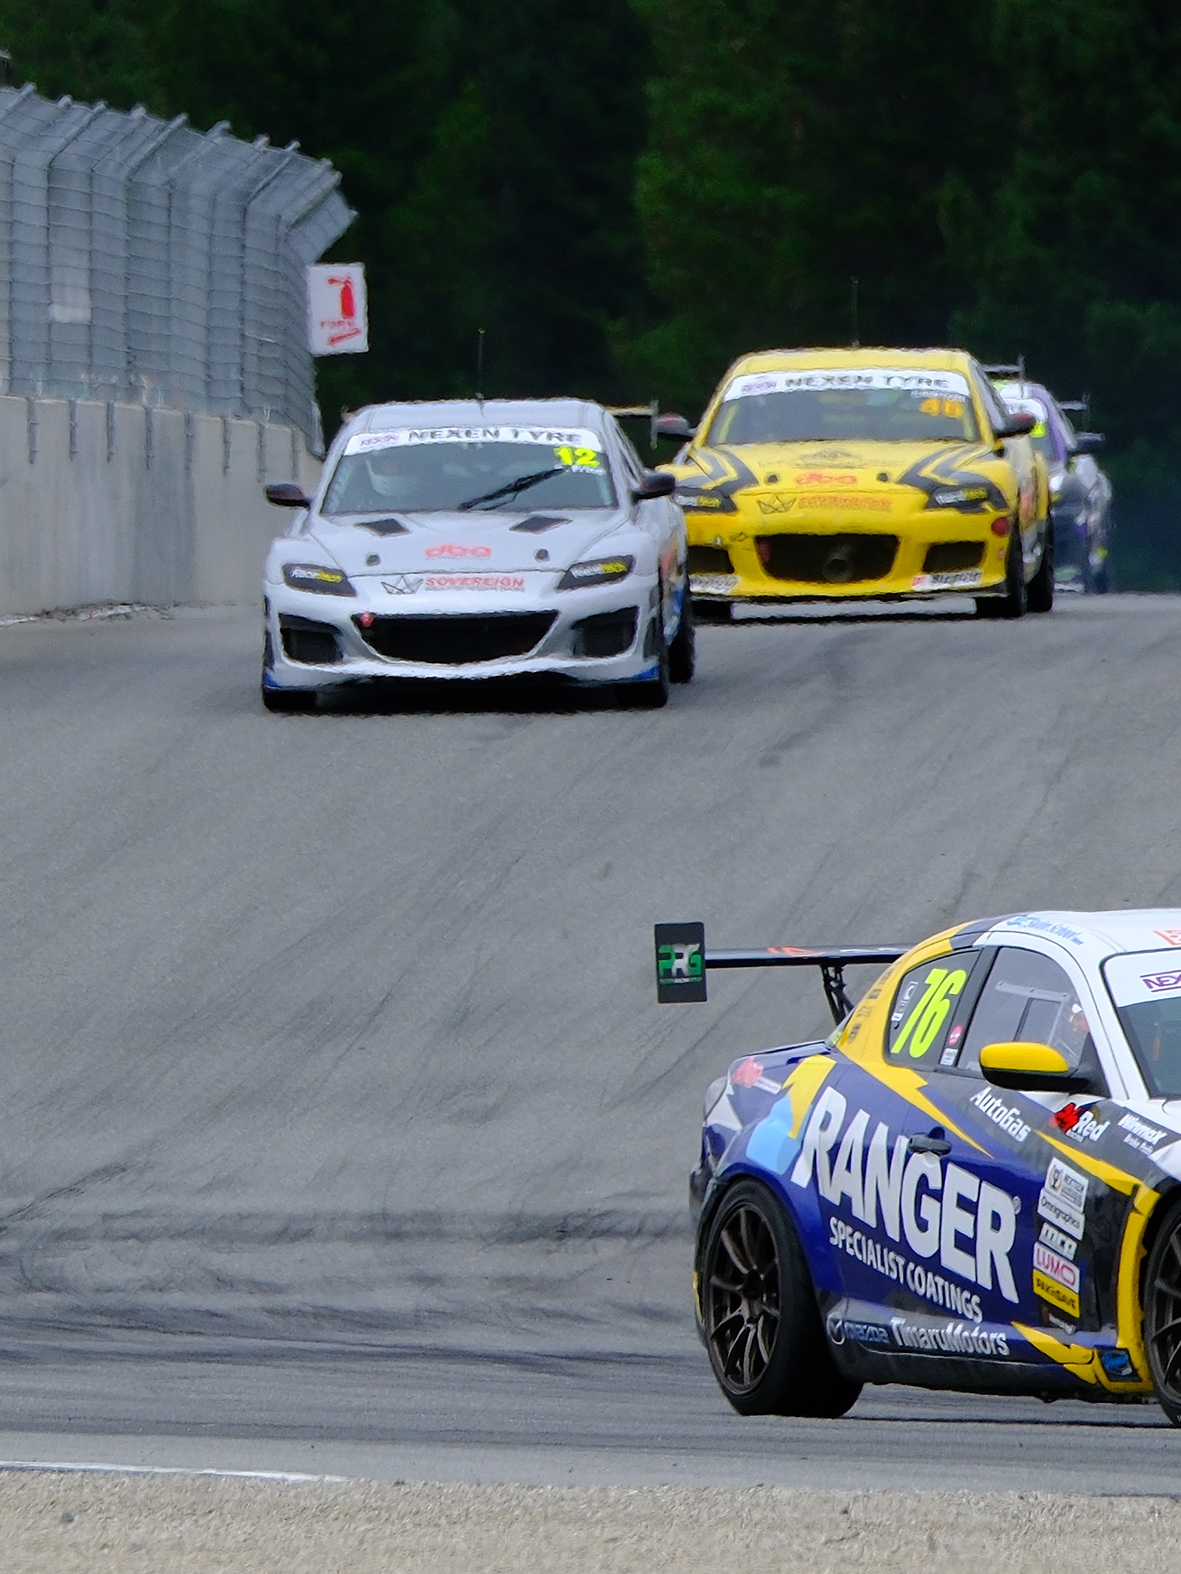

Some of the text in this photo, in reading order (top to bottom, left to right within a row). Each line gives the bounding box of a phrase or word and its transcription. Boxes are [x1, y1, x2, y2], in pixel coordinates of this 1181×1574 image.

[785, 375, 949, 389] NEXEN TYRE
[408, 428, 583, 444] NEXEN TYRE
[554, 446, 600, 468] 12
[425, 544, 492, 558] dba
[425, 576, 526, 588] SOVEREIGN
[890, 968, 967, 1058] 76
[970, 1087, 1031, 1143] AutoGas
[1073, 1111, 1110, 1142] Red
[790, 1086, 1019, 1303] RANGER
[829, 1217, 906, 1285] SPECIALIST
[906, 1261, 983, 1324] COATINGS
